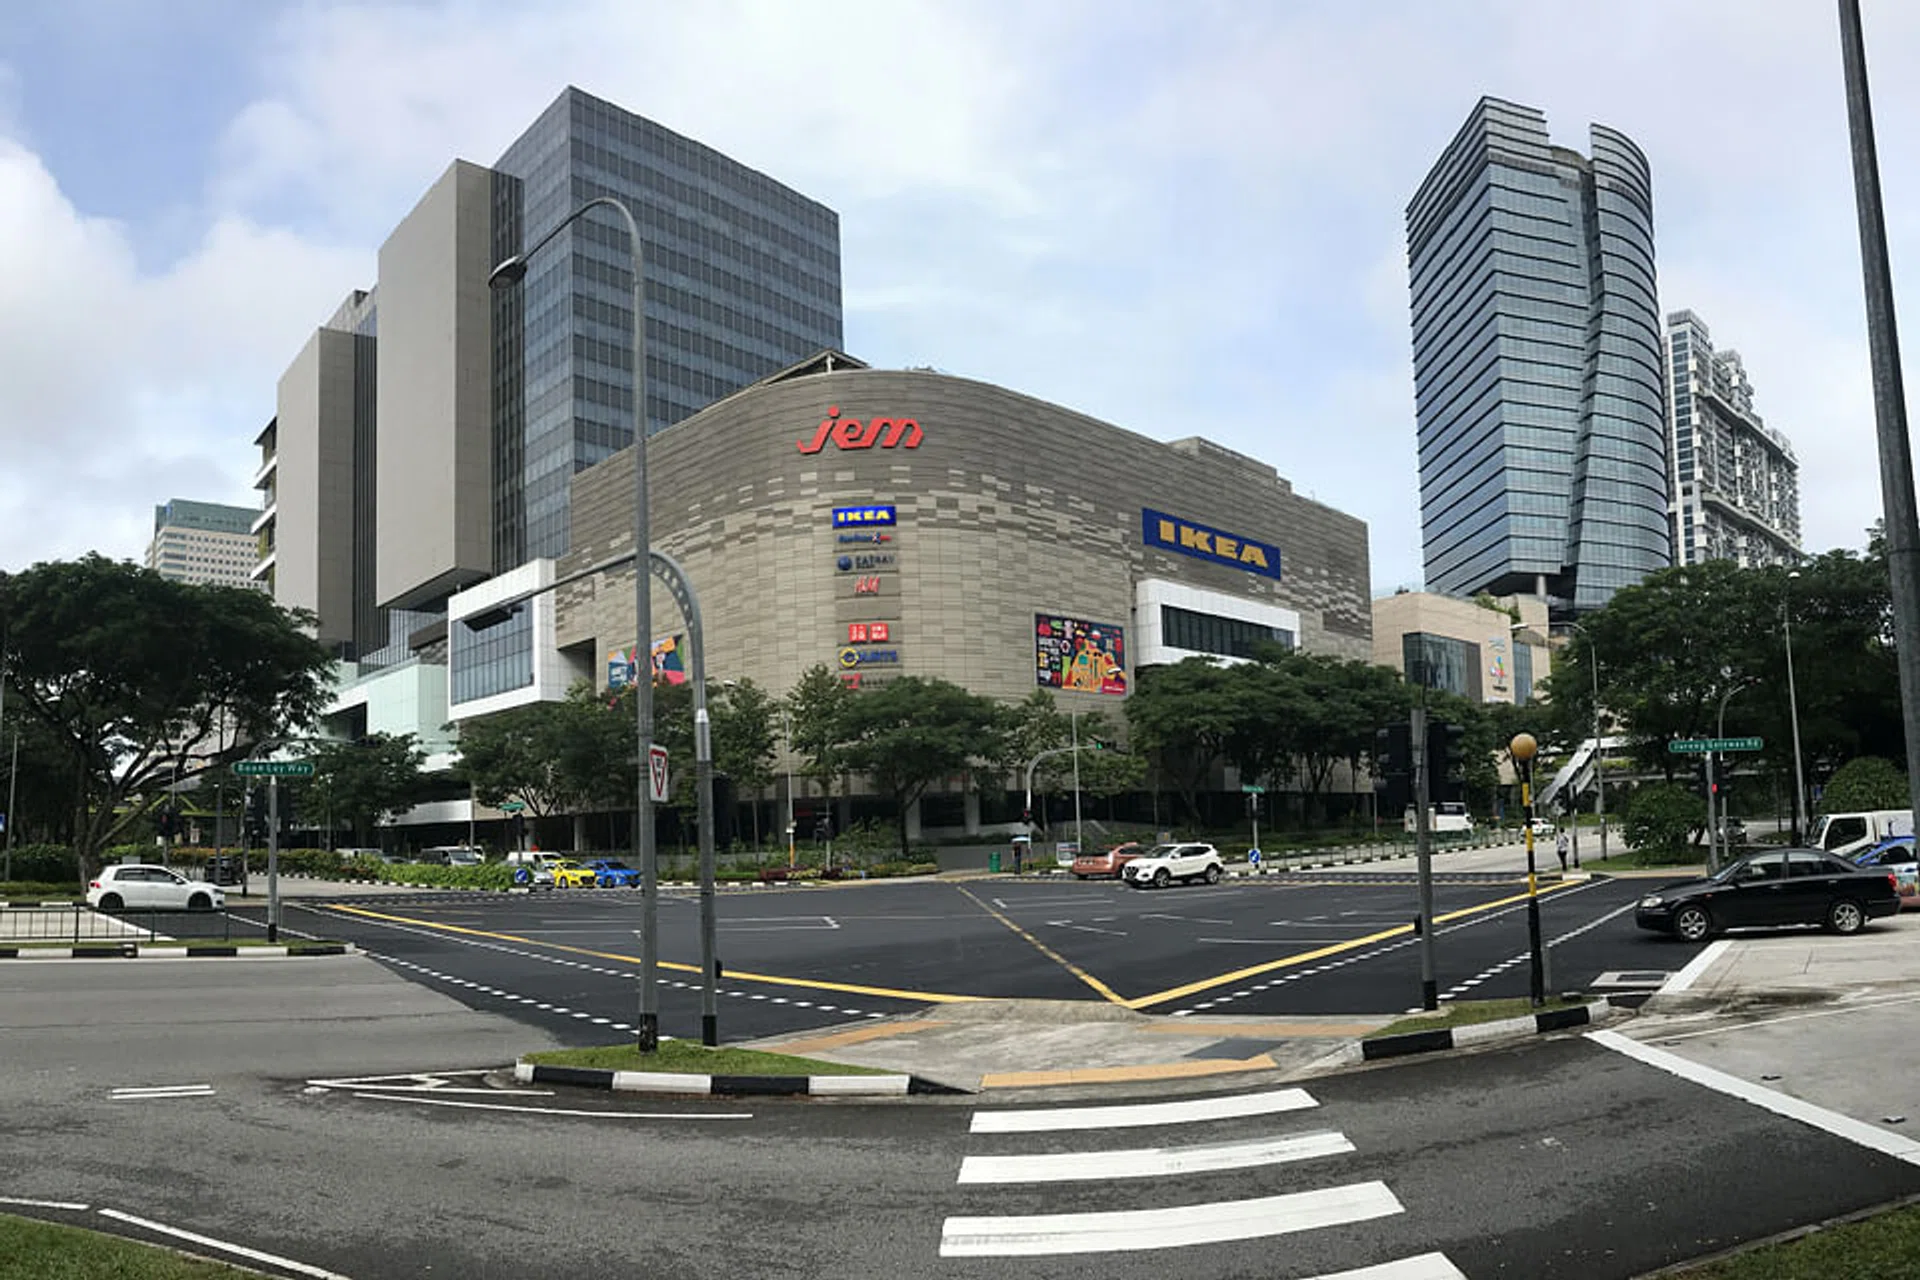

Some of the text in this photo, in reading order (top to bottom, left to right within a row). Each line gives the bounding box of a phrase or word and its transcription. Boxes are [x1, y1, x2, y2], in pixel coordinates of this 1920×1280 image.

[796, 405, 924, 454] jem
[838, 510, 890, 521] IKEA
[1159, 520, 1268, 568] IKEA
